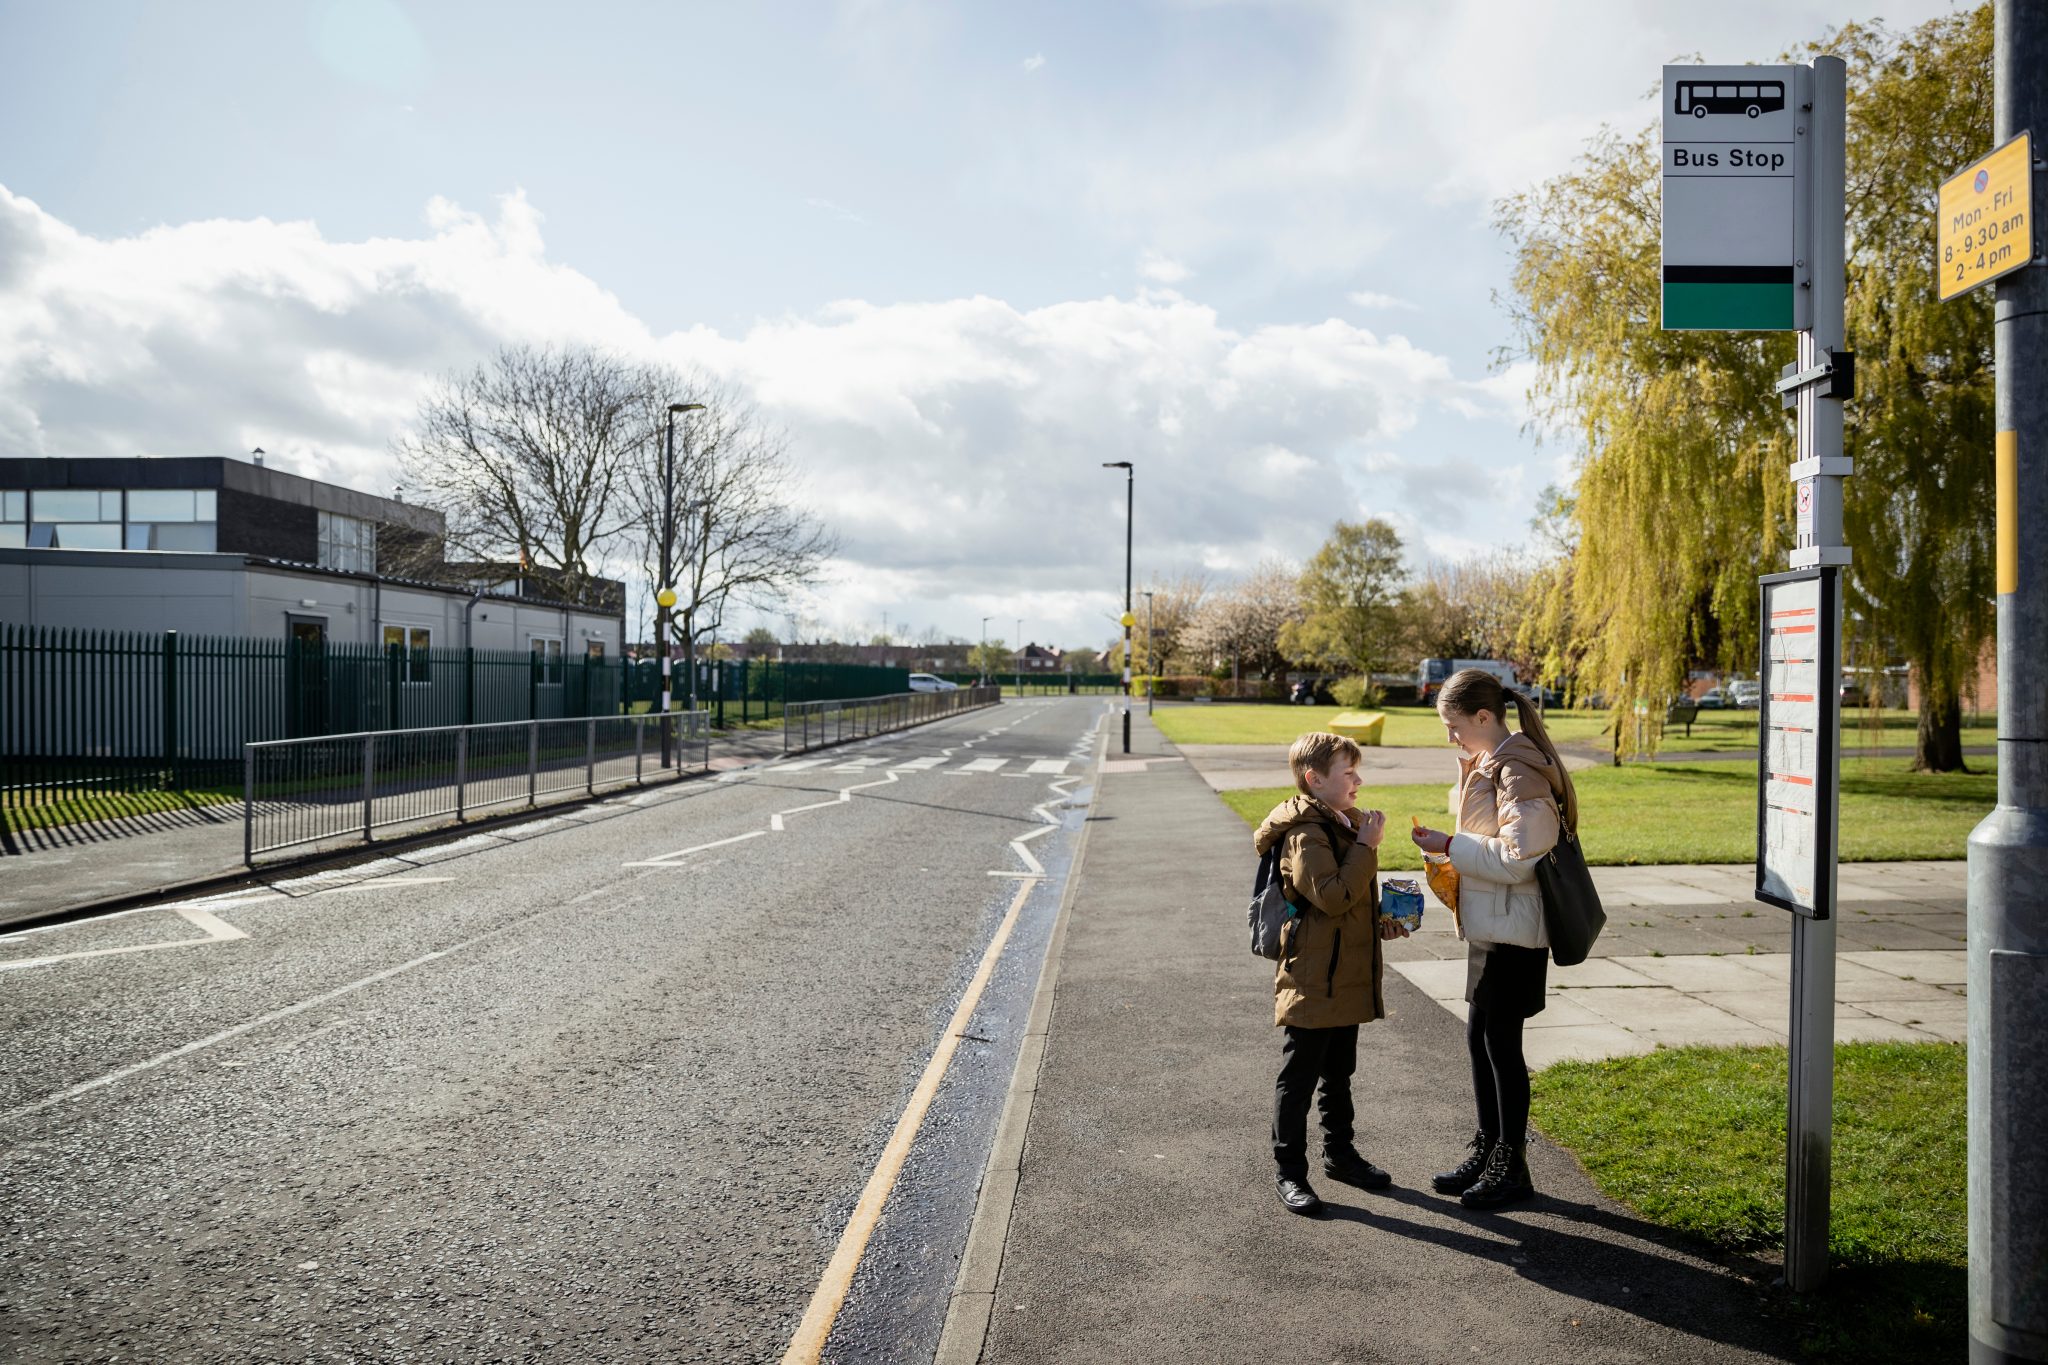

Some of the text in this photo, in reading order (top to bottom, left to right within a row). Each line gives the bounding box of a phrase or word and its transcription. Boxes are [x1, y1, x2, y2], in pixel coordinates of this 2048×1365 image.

[1674, 149, 1785, 171] Bus Stop
[1953, 207, 1981, 233] Mon
[1994, 185, 2012, 211] Fri
[1945, 246, 1953, 263] 8
[1964, 222, 1998, 253] 9.30
[2001, 212, 2023, 234] am
[1956, 263, 1965, 281] 2
[1976, 252, 1986, 269] 4
[1989, 244, 2011, 269] pm
